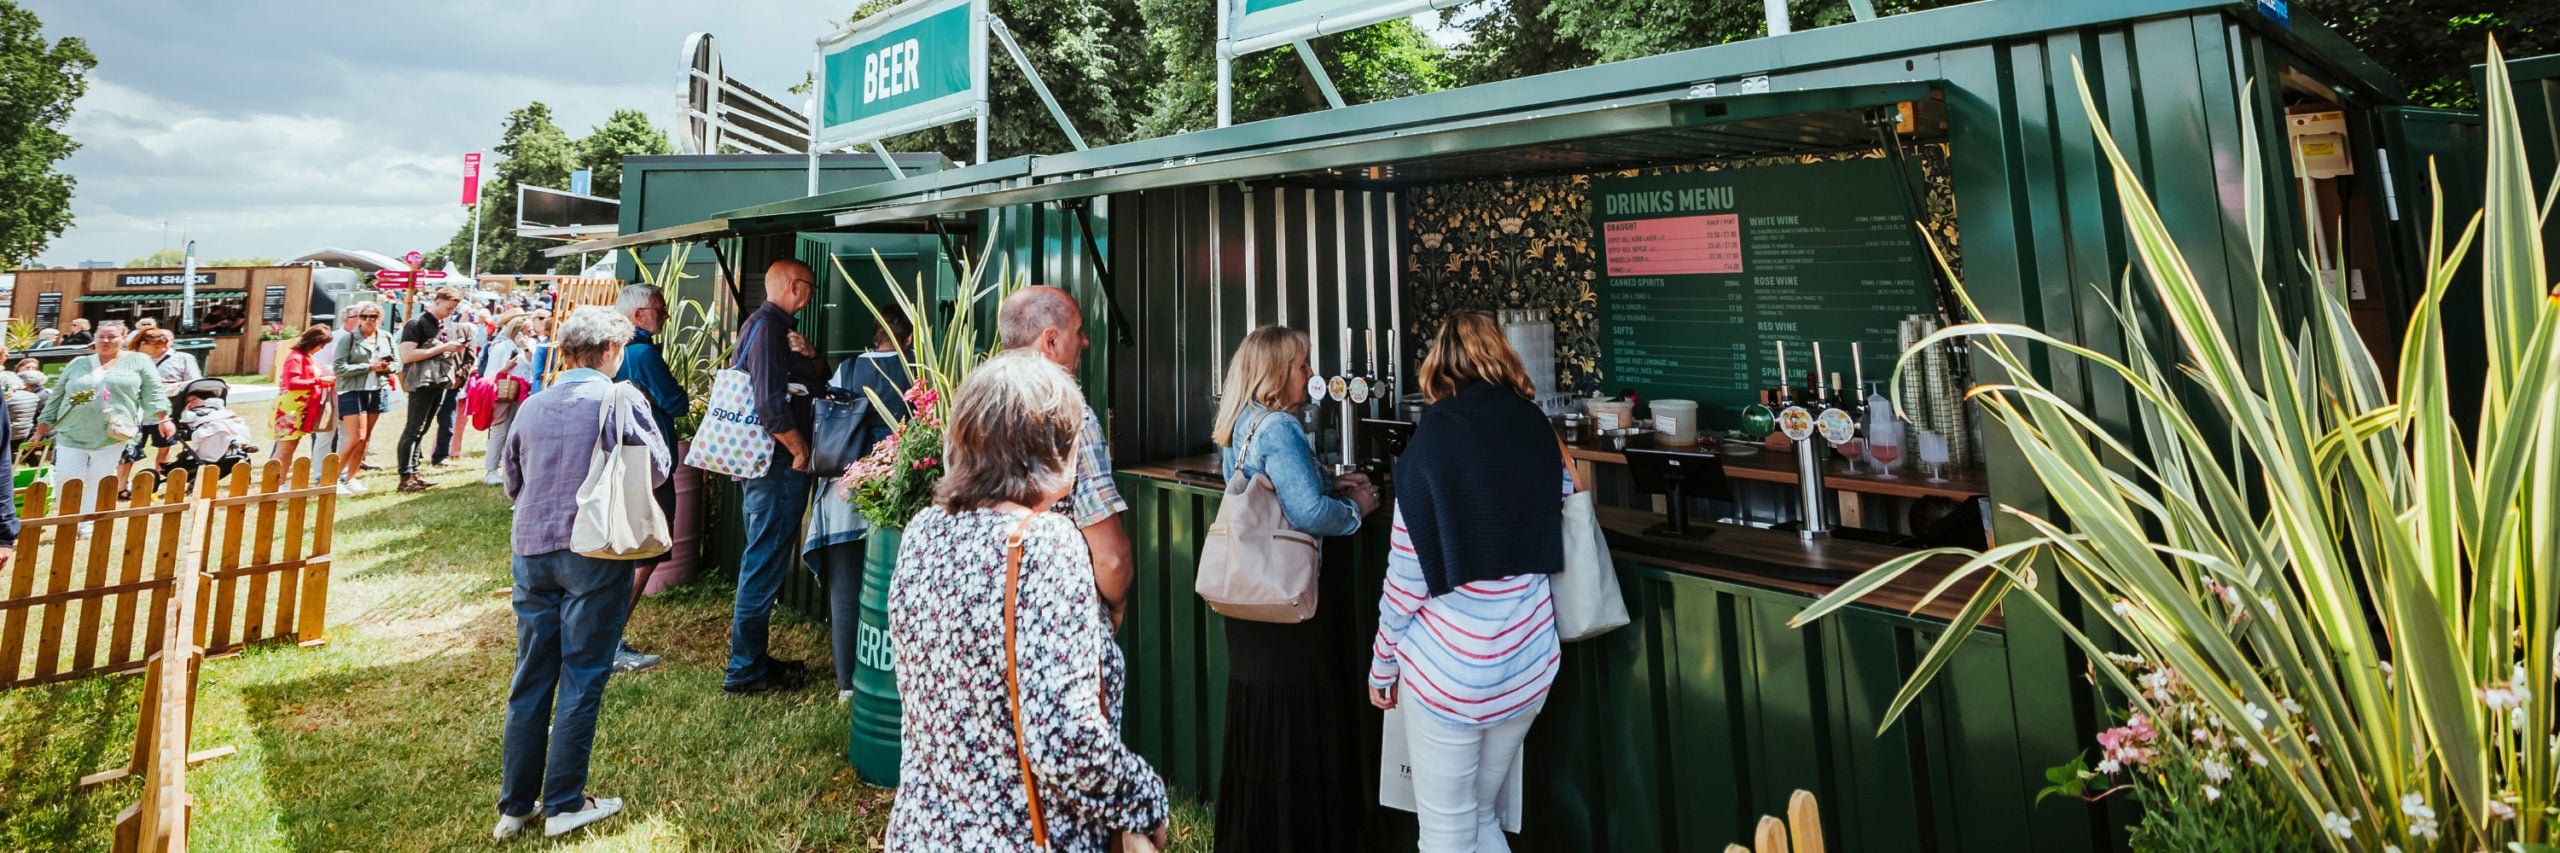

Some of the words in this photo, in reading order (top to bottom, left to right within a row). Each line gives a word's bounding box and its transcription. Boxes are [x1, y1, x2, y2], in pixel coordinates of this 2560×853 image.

[864, 38, 919, 104] BEER
[1606, 191, 1674, 215] DRINKS
[1679, 186, 1734, 211] MENU
[1749, 216, 1775, 226] WHITE
[1776, 215, 1799, 225] WINE
[1607, 223, 1637, 232] DRAUGHT
[126, 276, 158, 285] RUM
[1637, 278, 1664, 287] SPIRITS
[1754, 276, 1775, 286] ROSE
[1776, 276, 1798, 286] WINE
[1613, 326, 1634, 335] SOFTS
[1758, 322, 1773, 331] RED
[1775, 322, 1797, 332] WINE
[1762, 367, 1807, 379] SPALING
[713, 407, 744, 423] spot
[745, 414, 763, 426] on
[856, 619, 896, 671] ERB
